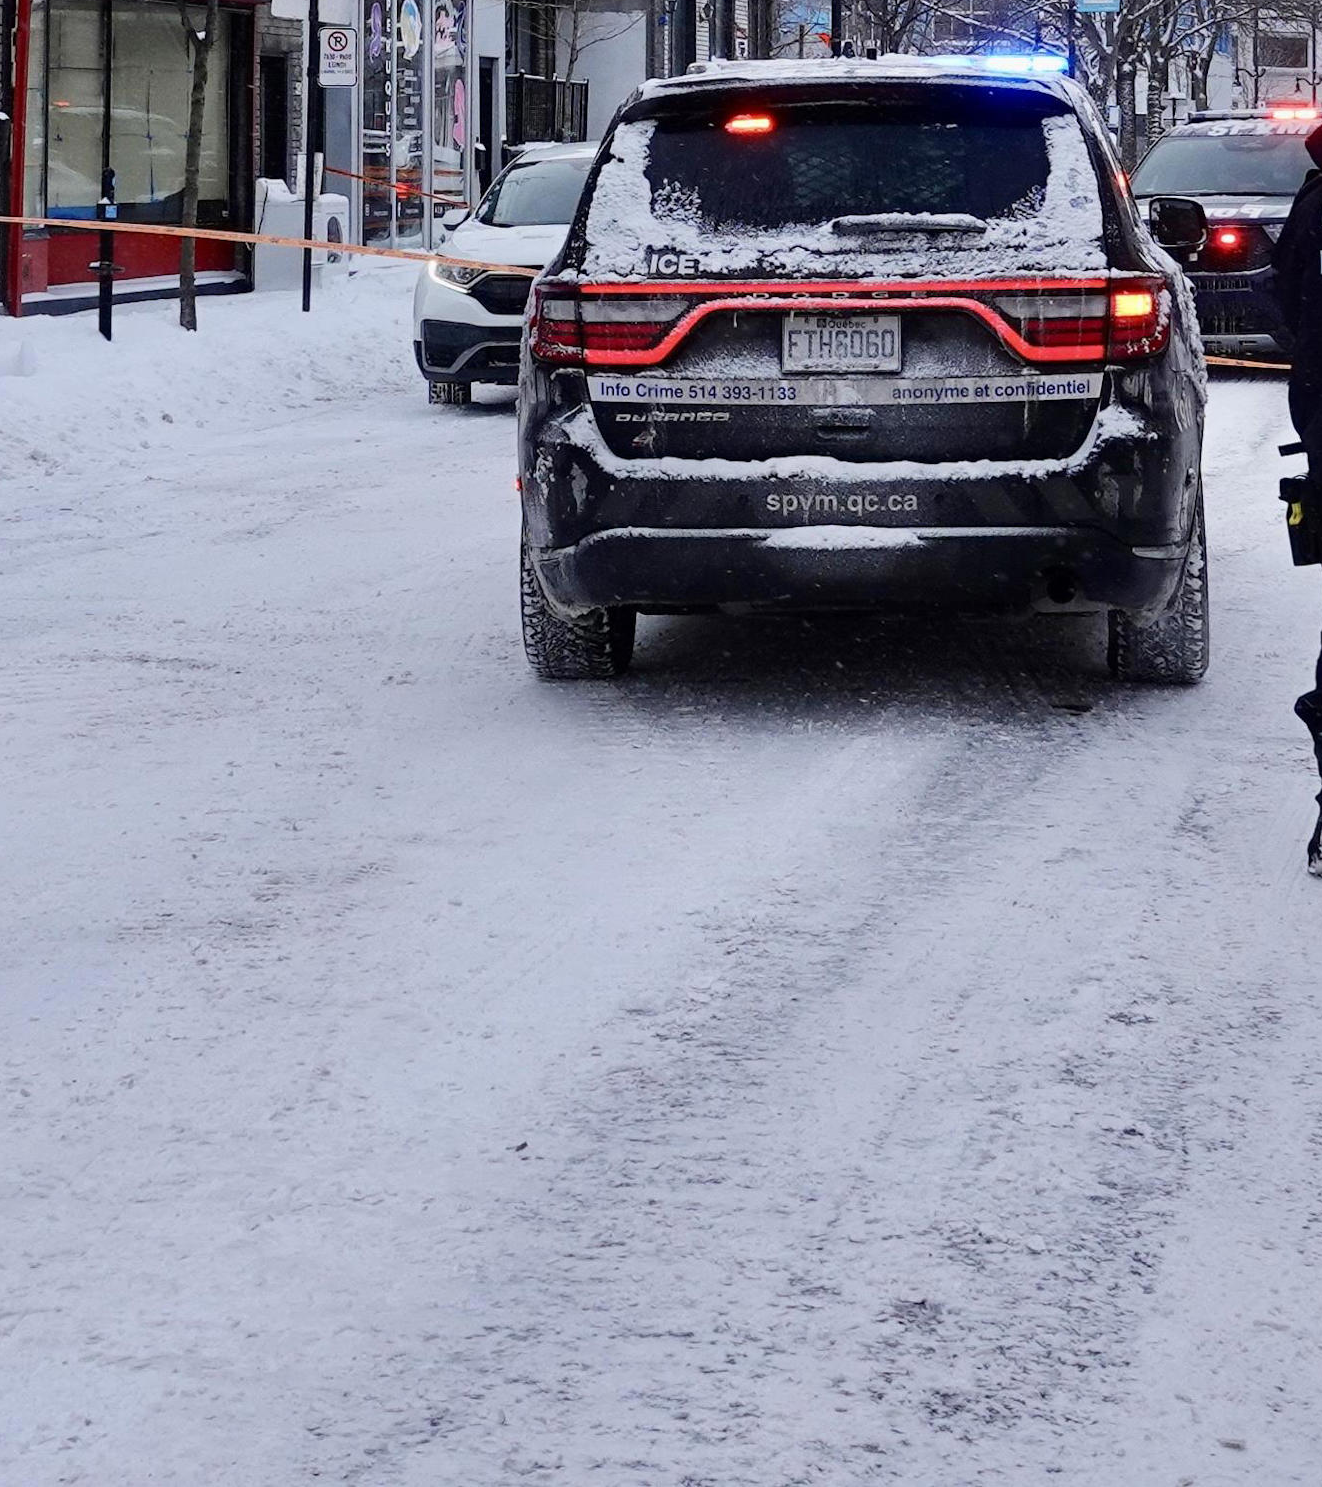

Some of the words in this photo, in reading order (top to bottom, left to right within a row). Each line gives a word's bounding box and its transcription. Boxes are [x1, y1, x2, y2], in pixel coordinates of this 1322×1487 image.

[752, 291, 928, 299] DODGE
[600, 383, 630, 397] Info
[636, 384, 683, 398] Crime
[689, 385, 717, 398] 514
[722, 386, 797, 400] 393-1133
[892, 386, 969, 401] anonyme
[975, 385, 992, 397] et
[995, 380, 1090, 396] confidentiel
[615, 412, 730, 423] DURANGO
[766, 493, 918, 516] spvm.qc.ca
